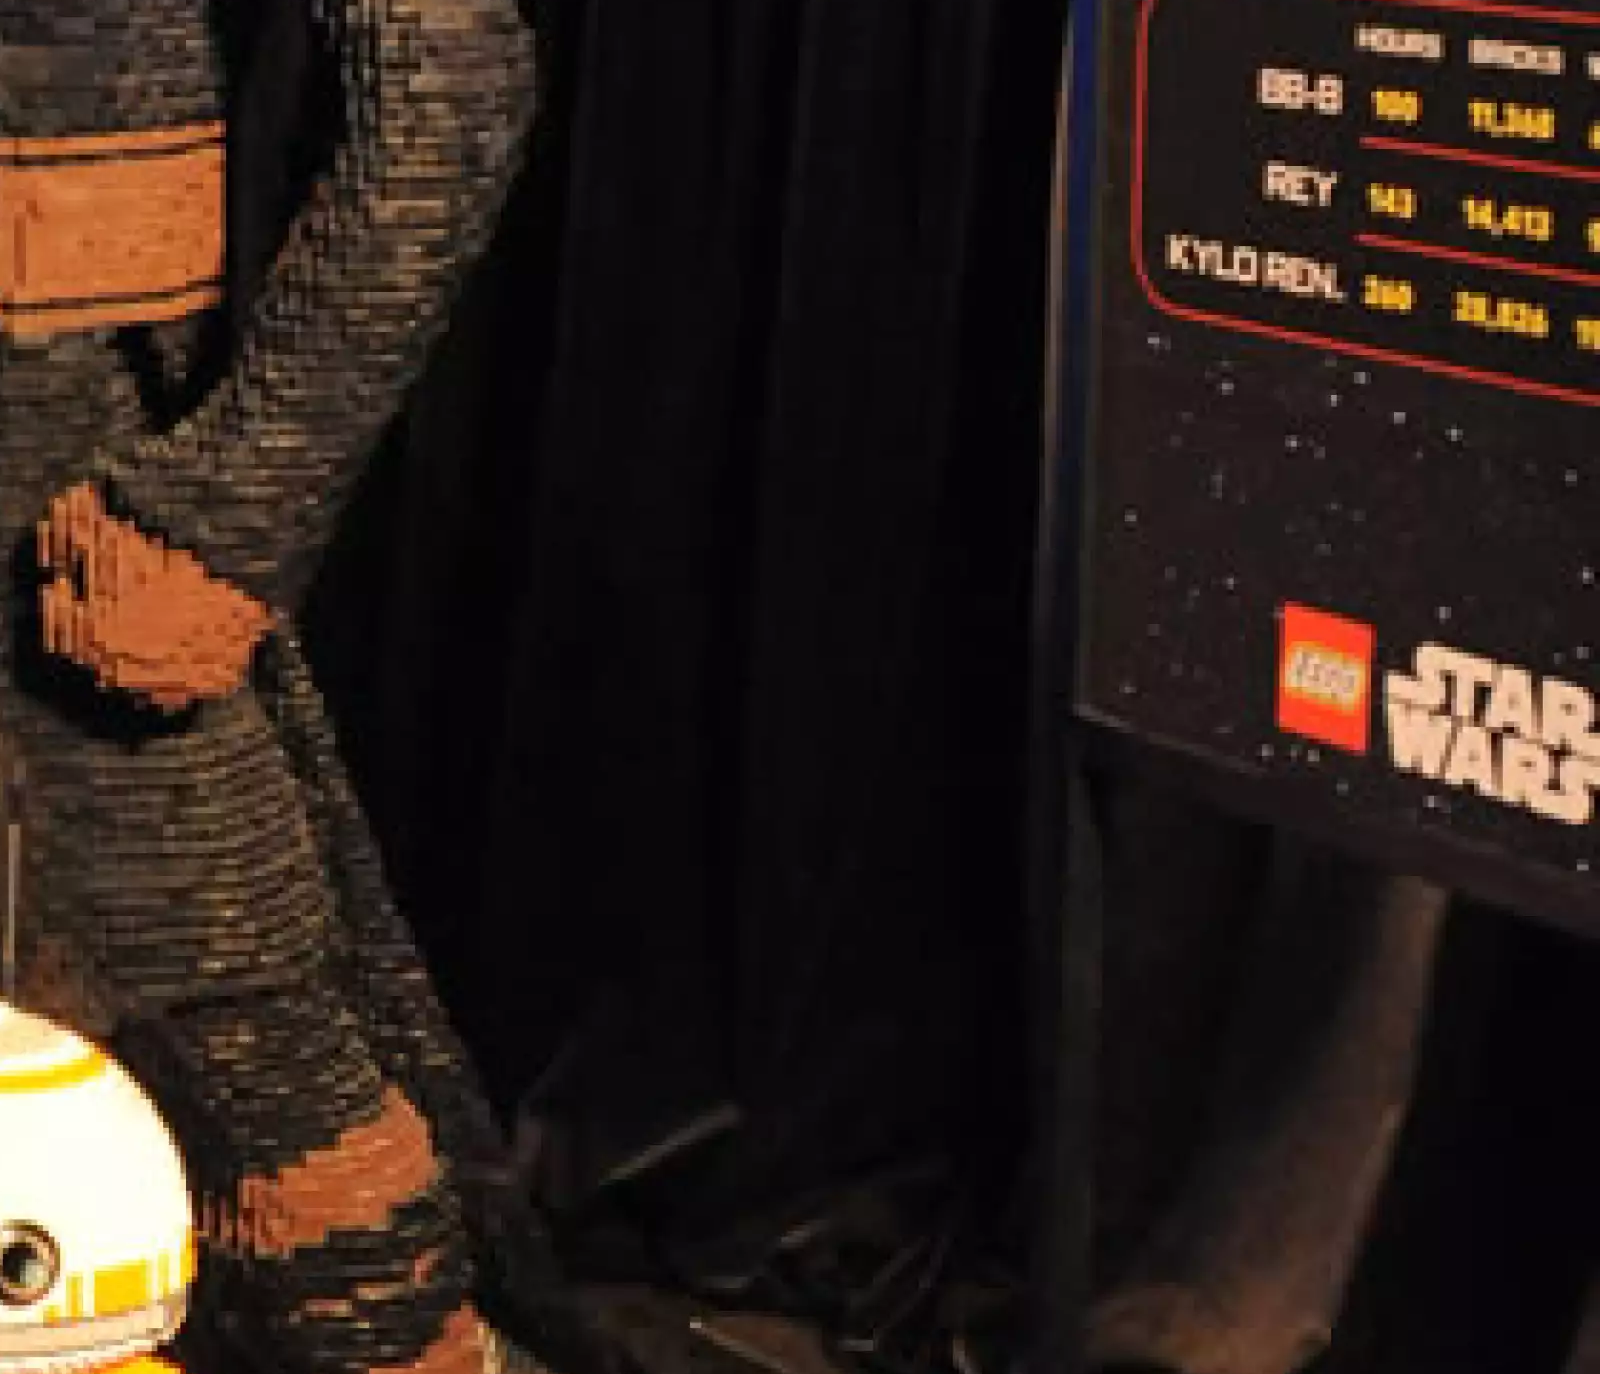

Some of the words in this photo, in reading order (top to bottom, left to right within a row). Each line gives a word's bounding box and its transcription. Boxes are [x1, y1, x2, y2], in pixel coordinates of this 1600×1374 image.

[1262, 161, 1339, 207] REY
[1165, 234, 1258, 286] KYLO
[1383, 640, 1600, 754] STAR
[1387, 701, 1600, 824] WARS
